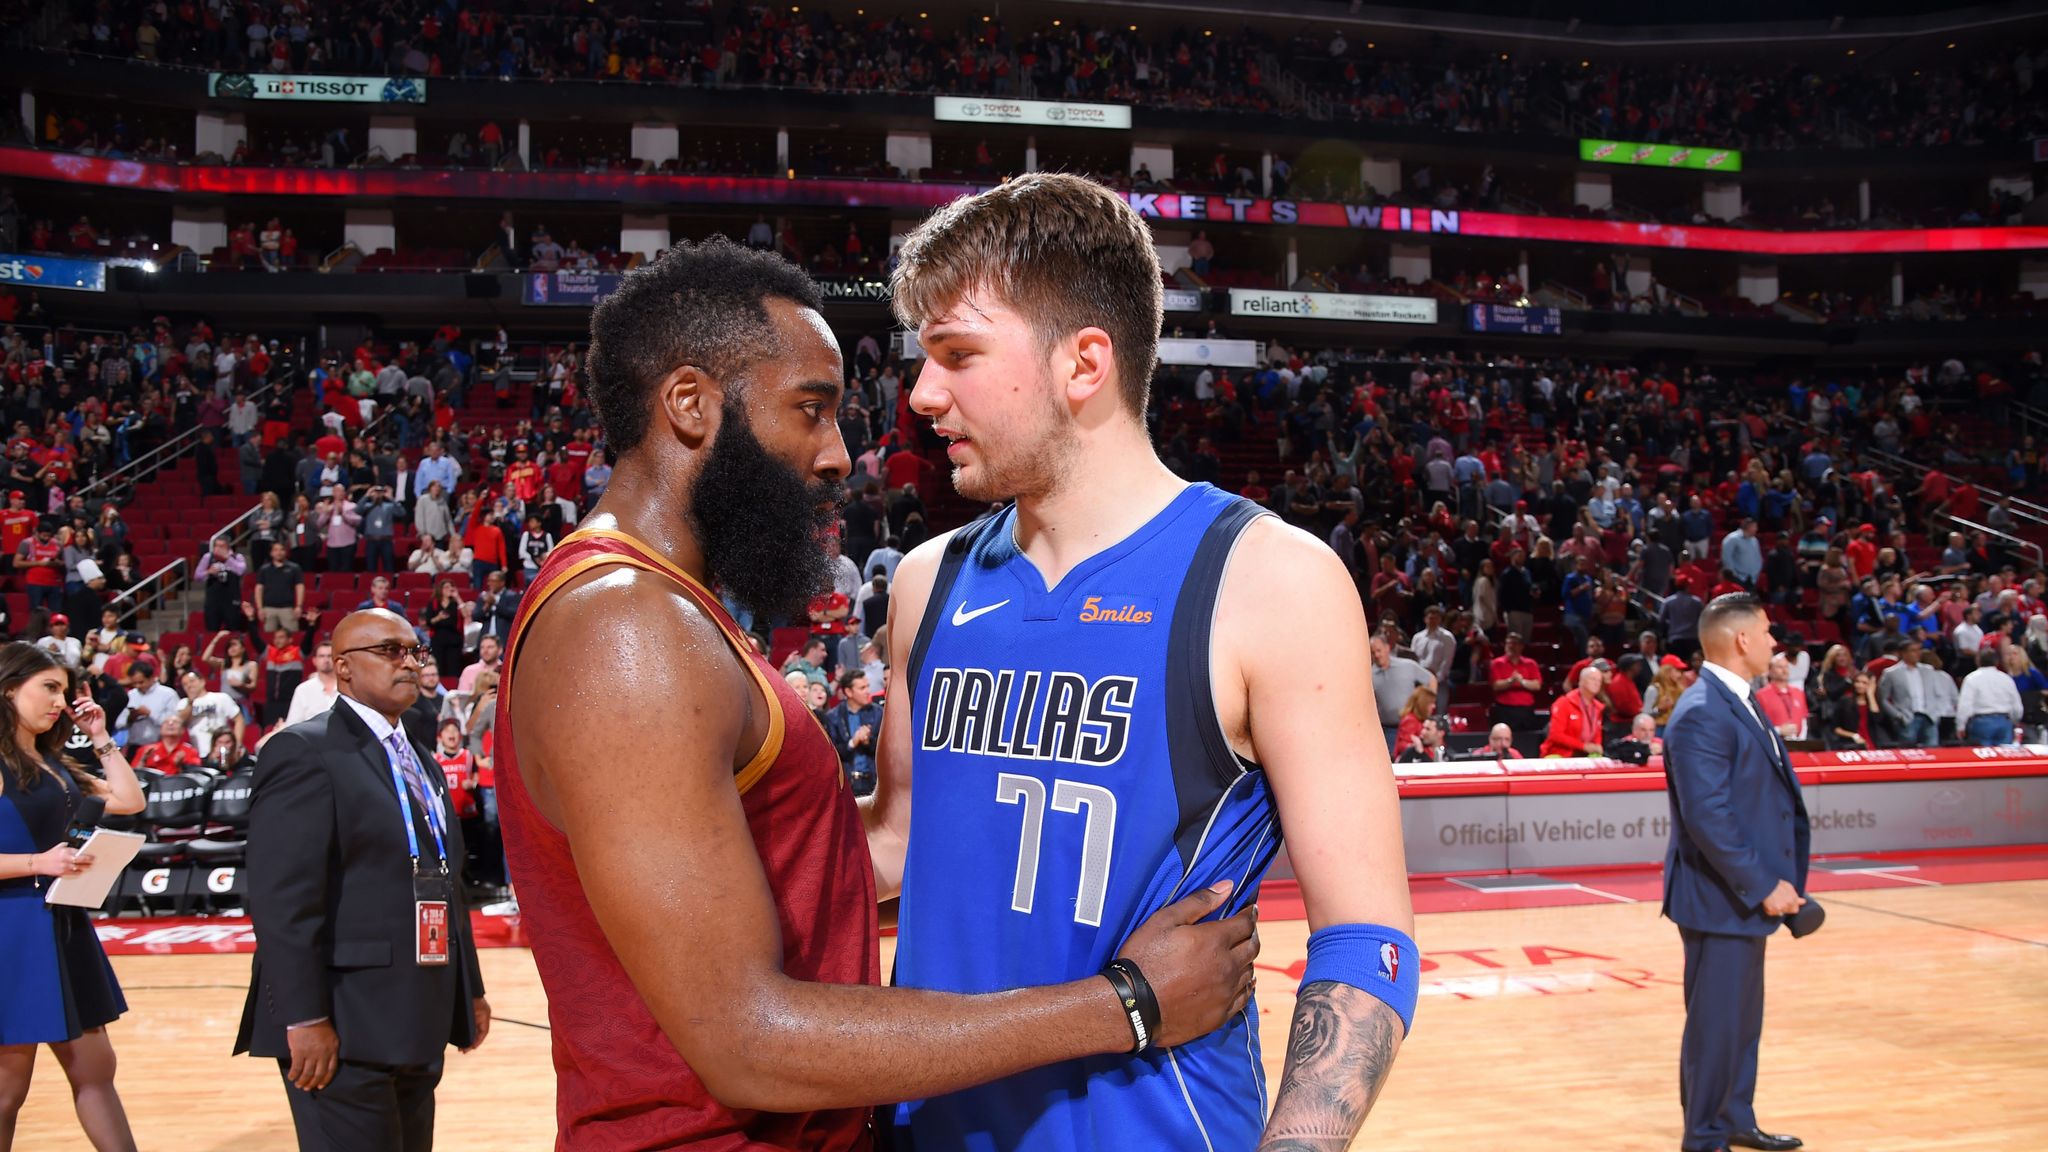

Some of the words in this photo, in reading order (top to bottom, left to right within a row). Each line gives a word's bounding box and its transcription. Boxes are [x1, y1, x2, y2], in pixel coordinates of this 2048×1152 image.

[296, 81, 369, 96] TISSOT
[983, 103, 1022, 113] TOYOTA
[1067, 107, 1105, 117] TOYOTA
[1131, 192, 1298, 225] KETS
[1346, 204, 1460, 234] WIN
[1243, 296, 1300, 314] reliant
[1354, 309, 1391, 318] Houston
[1392, 311, 1427, 320] Rockets
[1079, 595, 1153, 623] 5miles
[921, 667, 1139, 767] DALLAS
[1439, 821, 1525, 847] Official
[1532, 818, 1616, 843] Vehicle
[1622, 816, 1646, 839] of
[1809, 808, 1877, 831] ockets
[1921, 826, 1973, 841] TOYOTA
[996, 772, 1118, 928] 77
[1130, 1009, 1147, 1041] SWITCH
